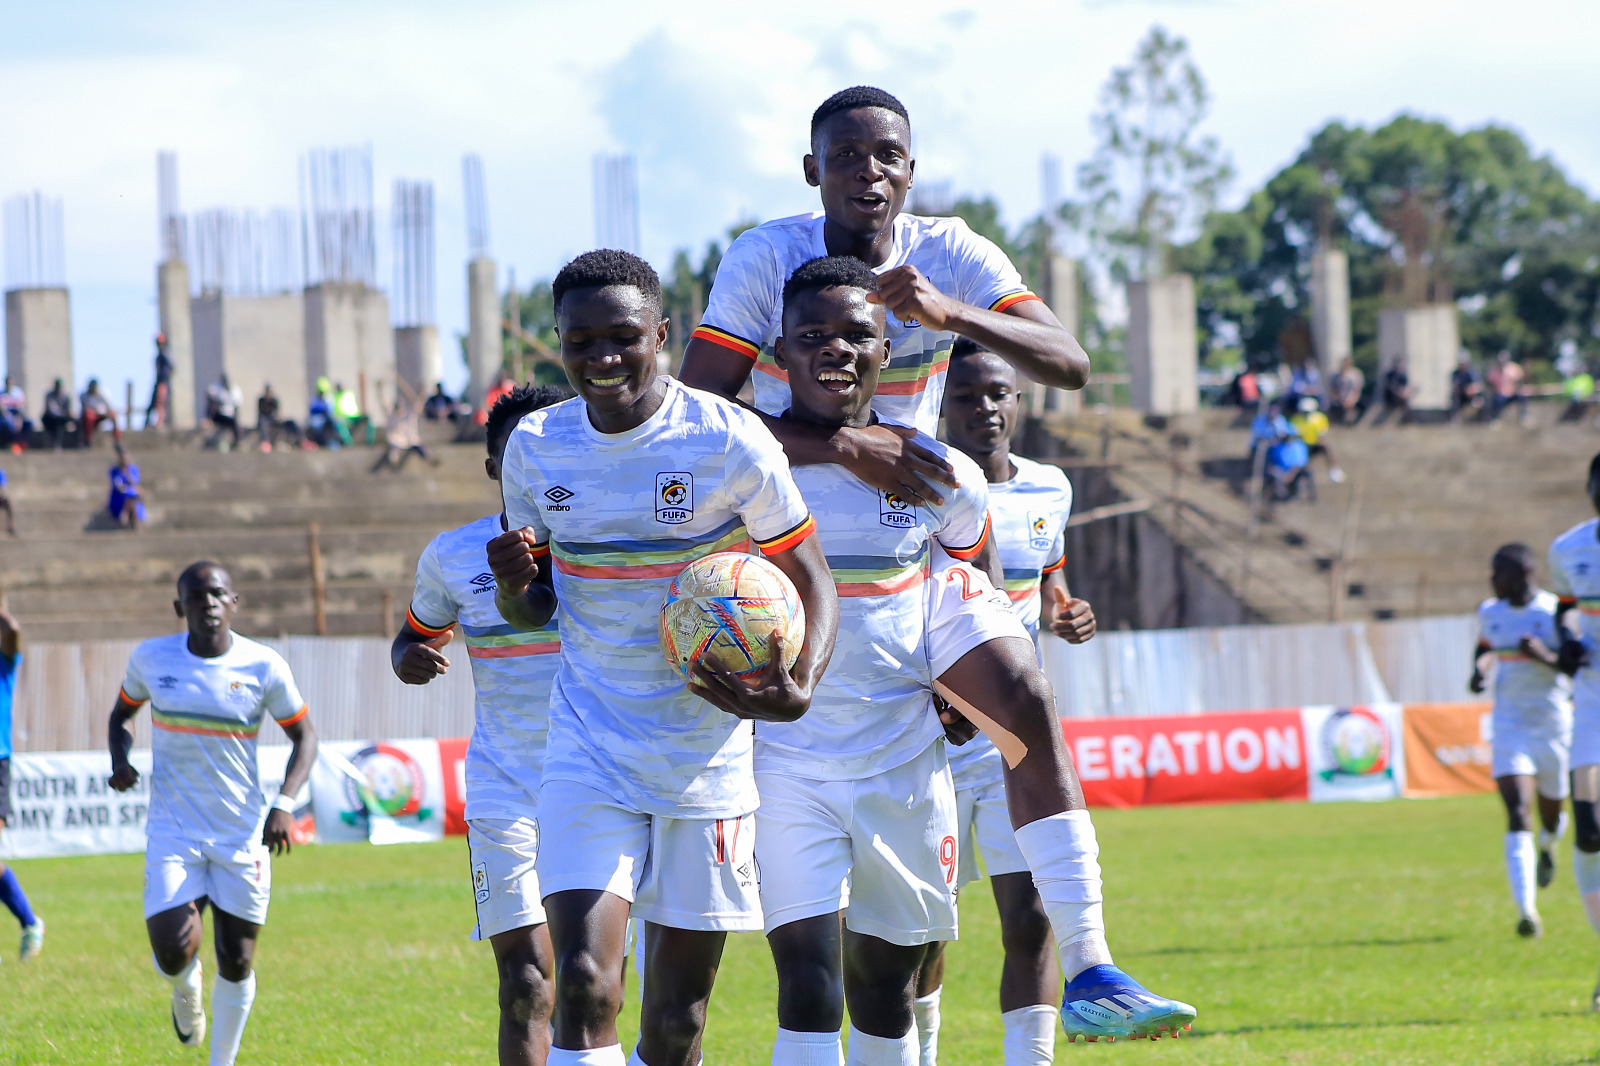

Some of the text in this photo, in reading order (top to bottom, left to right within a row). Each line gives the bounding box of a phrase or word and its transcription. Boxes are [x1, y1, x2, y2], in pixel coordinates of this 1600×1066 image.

[546, 504, 571, 512] umbro
[662, 511, 687, 519] FUFA
[887, 514, 911, 523] FUFA
[945, 567, 983, 601] 2
[1067, 726, 1300, 781] ERATION
[13, 774, 76, 799] OUTH
[66, 806, 110, 827] AND
[939, 835, 957, 885] 9
[1080, 1005, 1112, 1020] CRAZYFAST
